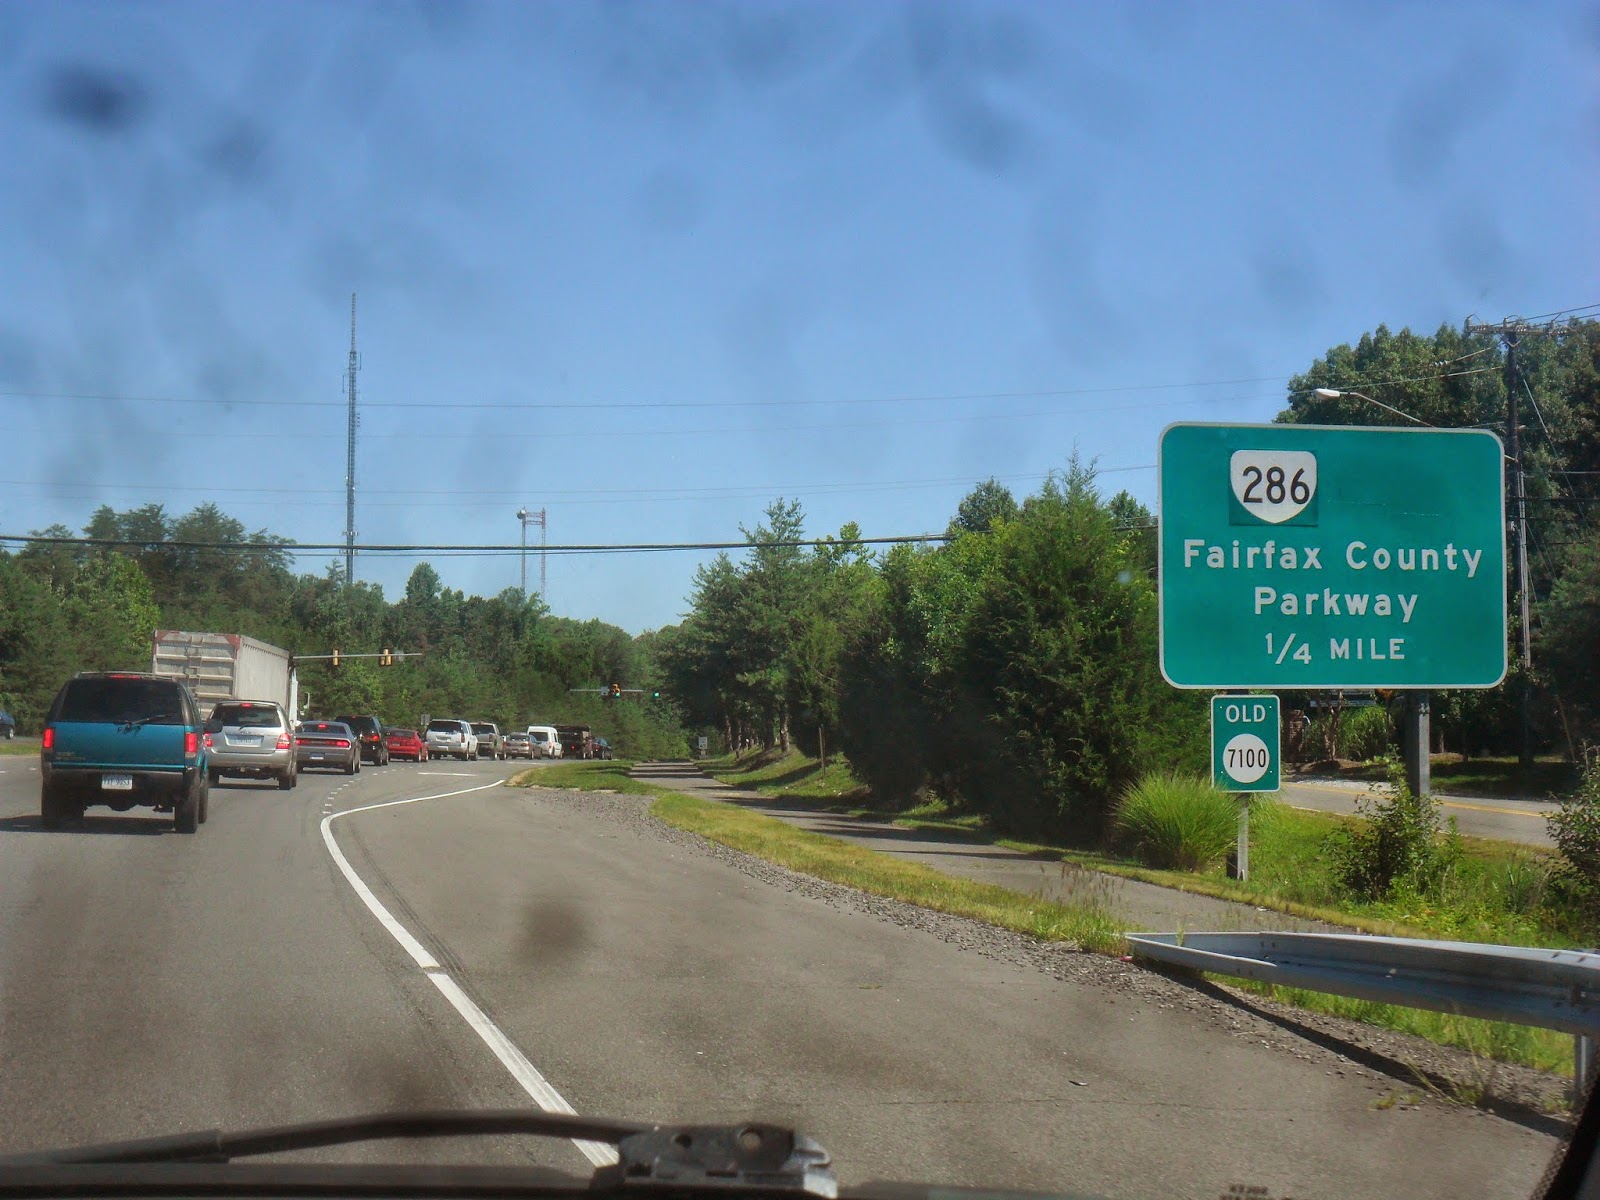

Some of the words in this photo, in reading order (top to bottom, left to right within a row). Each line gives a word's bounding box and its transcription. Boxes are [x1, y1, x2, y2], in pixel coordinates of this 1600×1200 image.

[1242, 466, 1310, 505] 286
[1184, 540, 1322, 570] Fairfax
[1345, 541, 1482, 578] County
[1254, 587, 1418, 623] Parkway
[1264, 633, 1312, 665] 1/4
[1330, 638, 1405, 660] MILE
[1225, 704, 1266, 723] OLD
[1227, 748, 1267, 768] 7100
